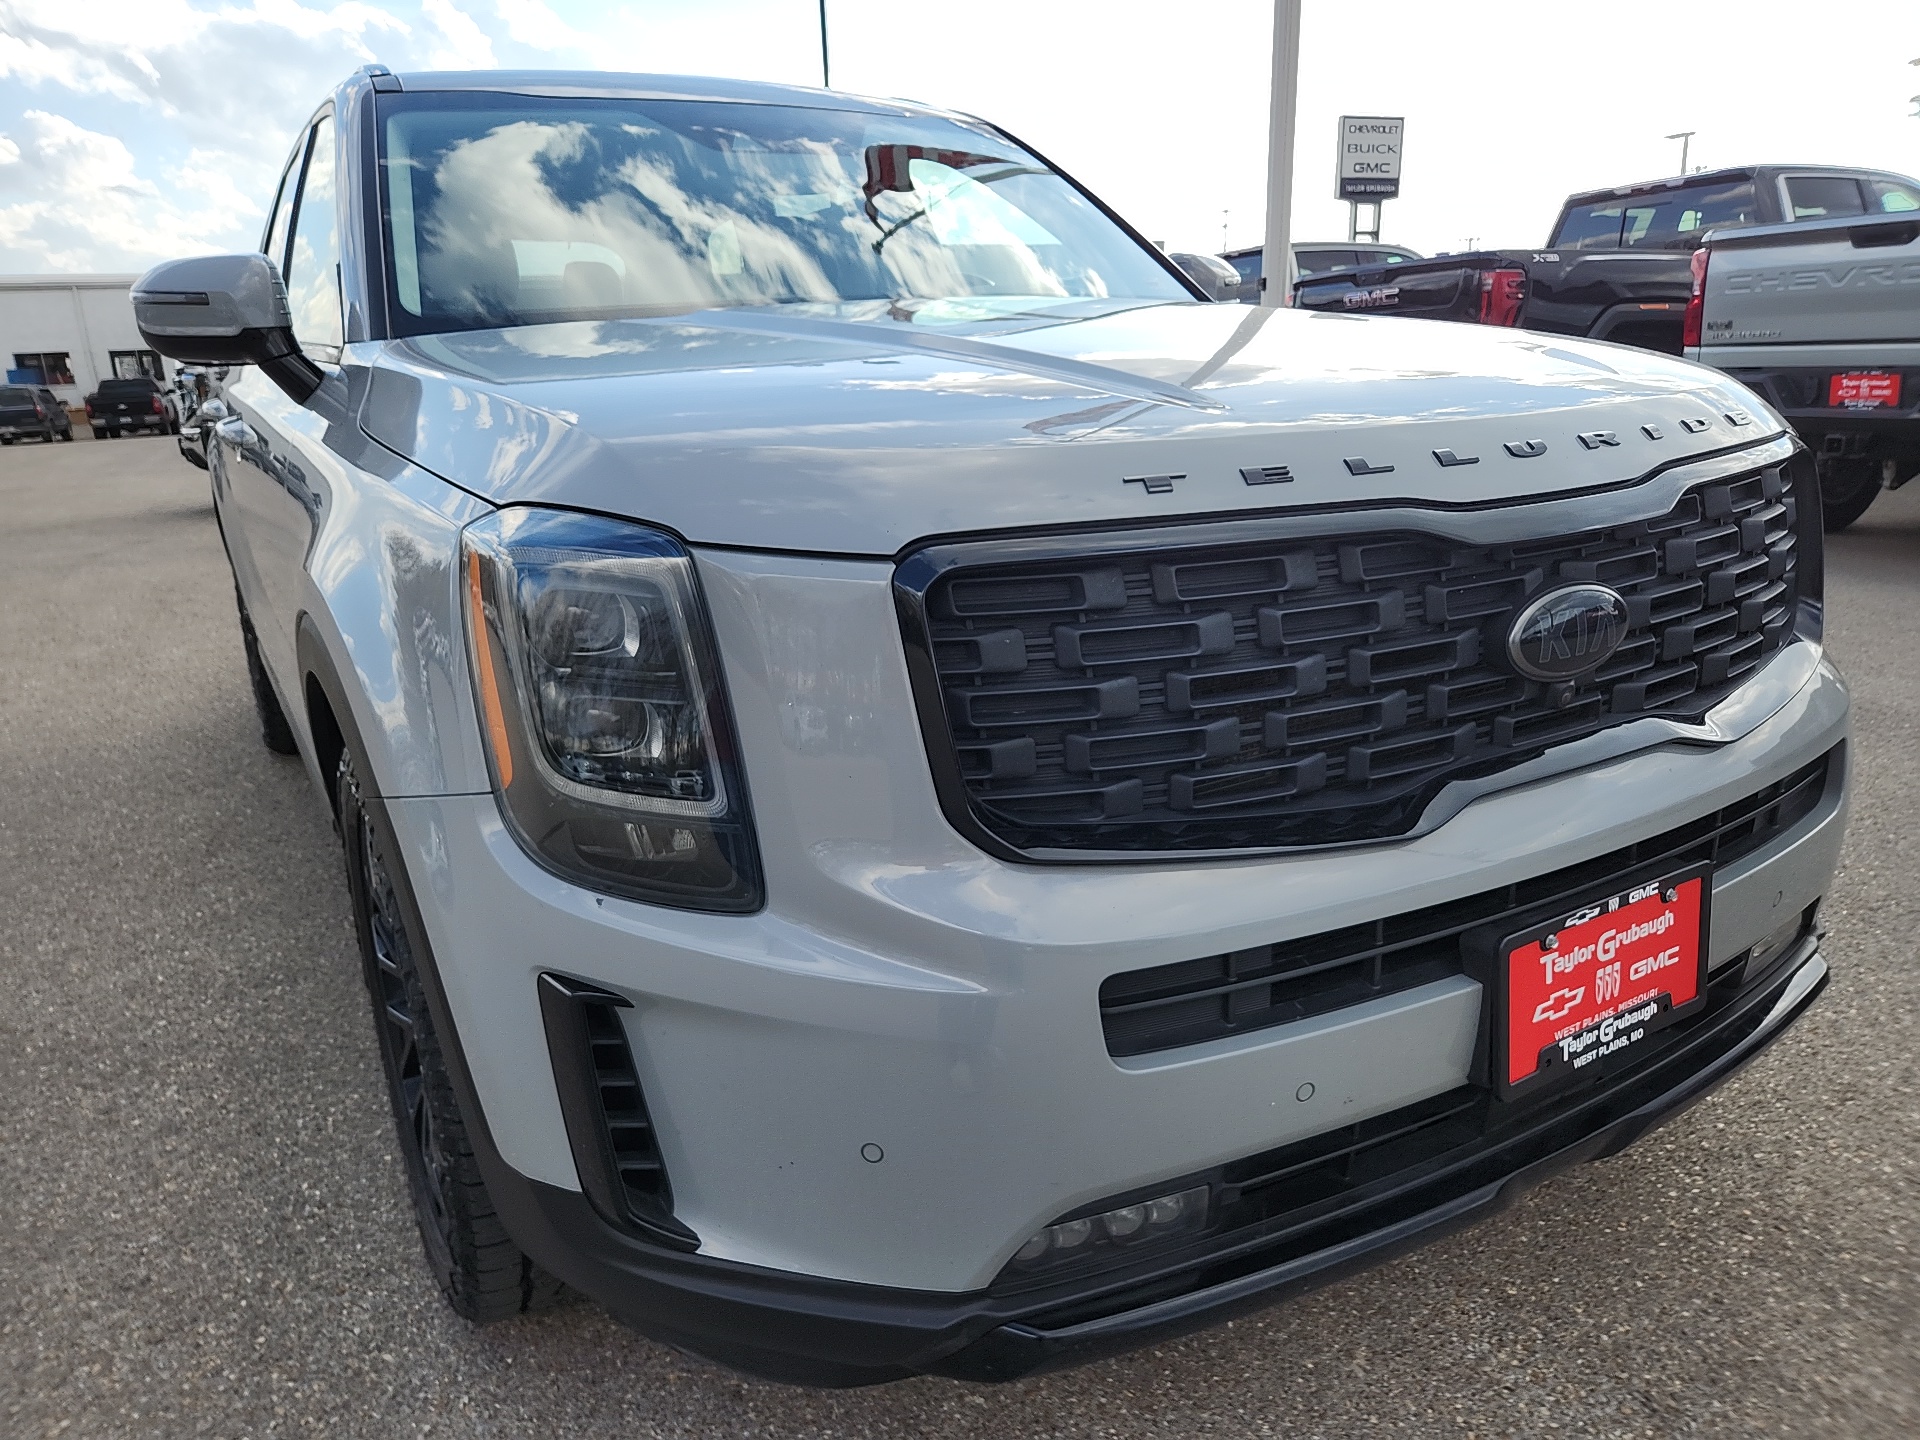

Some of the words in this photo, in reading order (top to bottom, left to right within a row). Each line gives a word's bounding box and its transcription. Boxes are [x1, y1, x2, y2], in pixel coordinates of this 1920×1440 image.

[1347, 143, 1397, 154] BUICK
[1348, 124, 1399, 134] CHEVROLET
[1353, 162, 1391, 173] GMC
[1342, 287, 1400, 309] GMC
[1122, 410, 1752, 494] TELLURIDE
[1537, 604, 1618, 663] KIA
[1629, 882, 1660, 904] GMC
[1540, 944, 1596, 985] Taylor
[1596, 909, 1674, 962] Grubaugh
[1629, 945, 1680, 981] GMC
[1554, 1021, 1582, 1041] WEST
[1618, 987, 1659, 1012] MISSOURI
[1559, 1030, 1599, 1062] Taylor
[1600, 1001, 1658, 1043] Grubaugh
[1573, 1049, 1598, 1069] WEST
[1598, 1035, 1629, 1058] PLAINS,
[1630, 1027, 1644, 1043] MO
